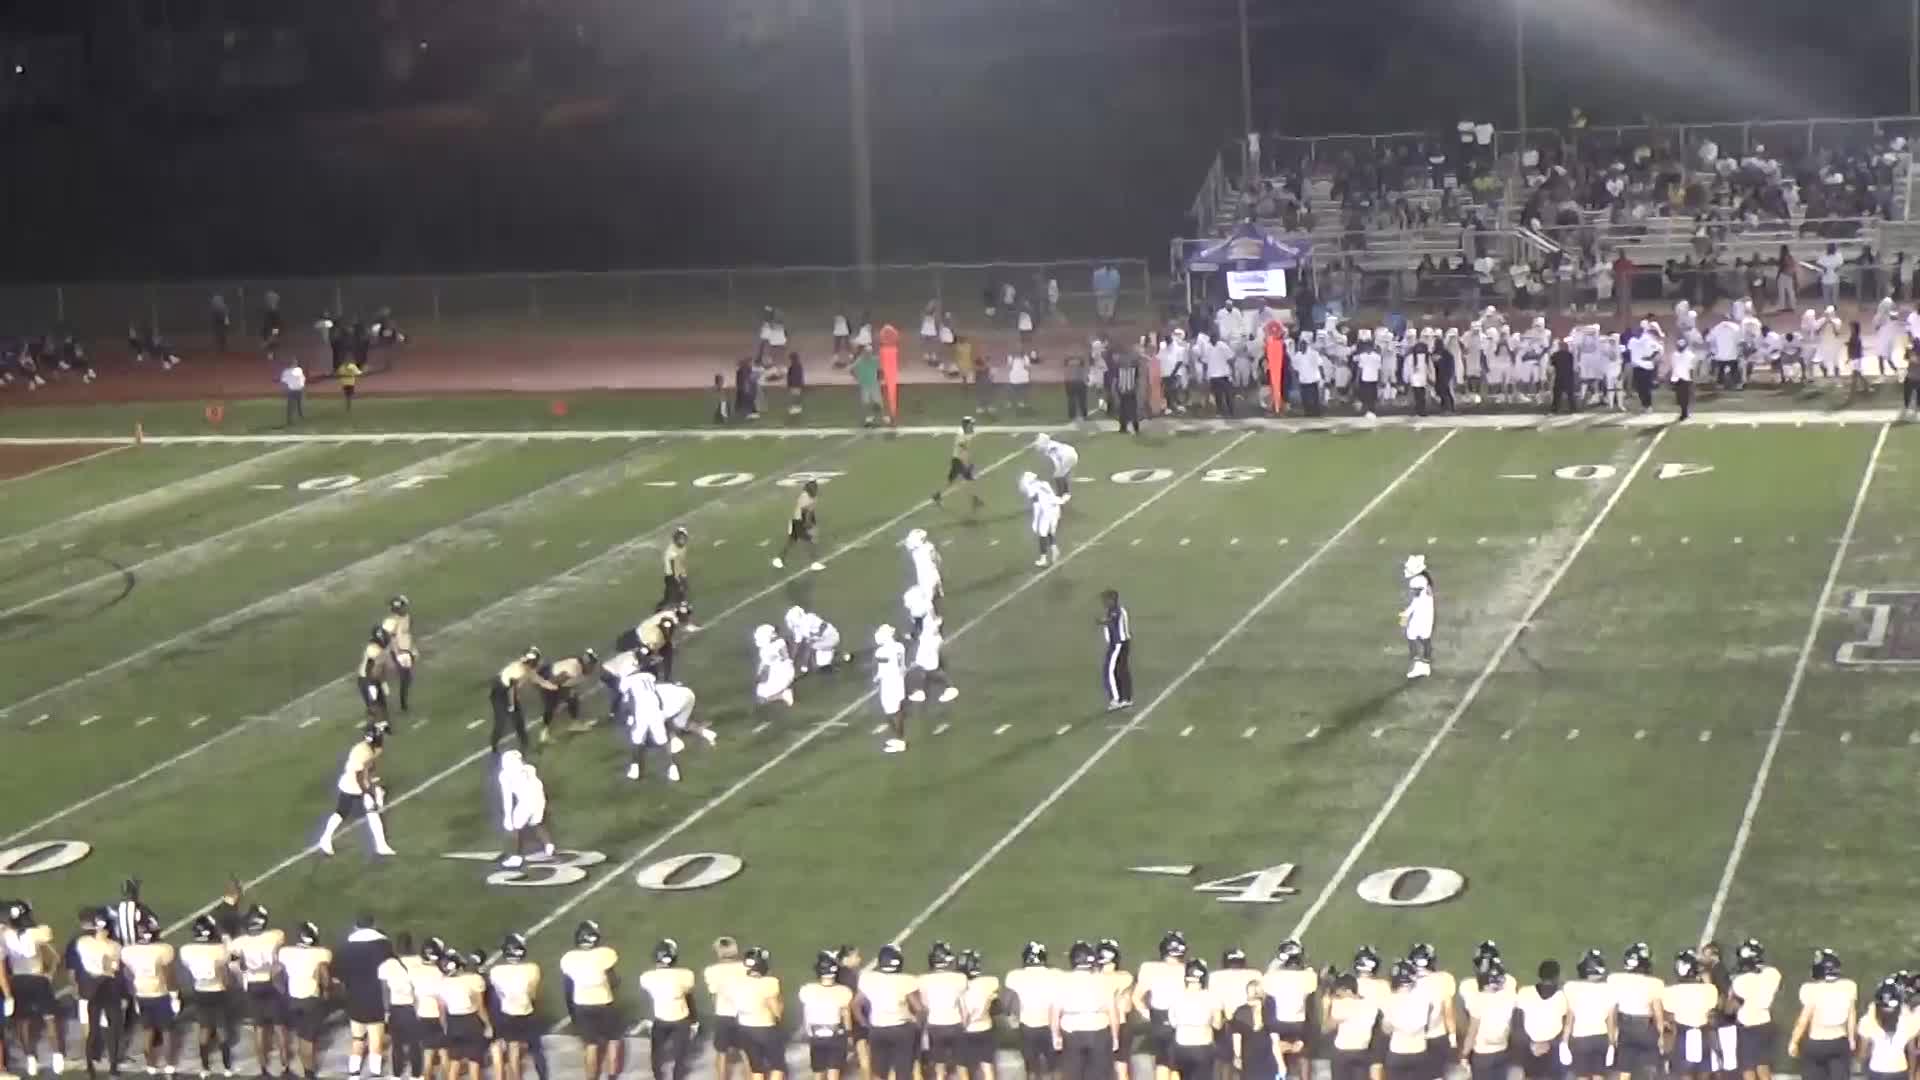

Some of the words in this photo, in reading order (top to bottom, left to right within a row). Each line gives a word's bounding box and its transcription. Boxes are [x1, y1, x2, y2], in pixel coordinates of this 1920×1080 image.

[1554, 463, 1715, 479] 40
[487, 850, 744, 890] 30
[1193, 863, 1465, 906] 40
